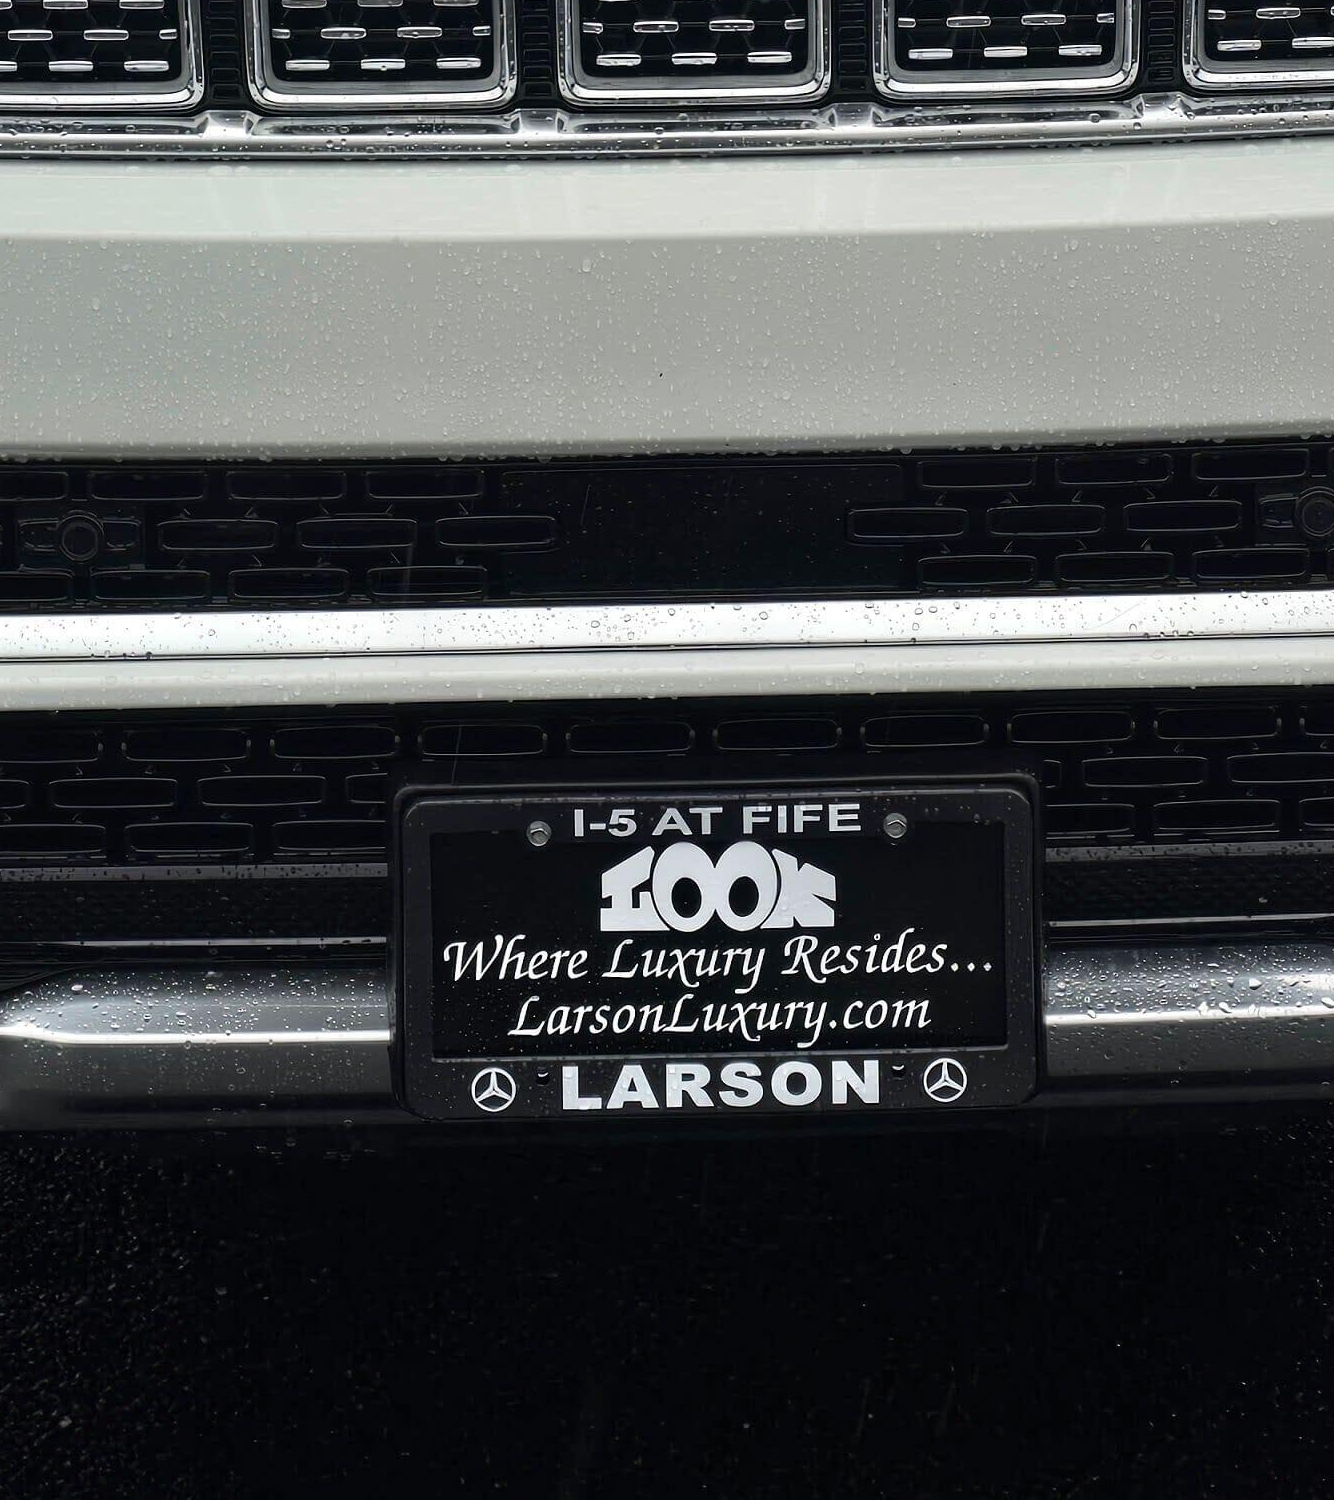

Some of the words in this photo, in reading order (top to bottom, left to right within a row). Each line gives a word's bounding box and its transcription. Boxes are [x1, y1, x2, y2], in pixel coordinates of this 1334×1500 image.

[574, 808, 637, 837] I-5
[652, 806, 723, 836] AT
[743, 803, 862, 835] FIFE
[600, 841, 837, 932] LOOK
[443, 934, 589, 982] Where
[601, 939, 765, 994] Luxury
[781, 927, 992, 983] Resides...
[507, 994, 931, 1048] LarsonLuxury.com
[562, 1059, 880, 1111] LARSON
